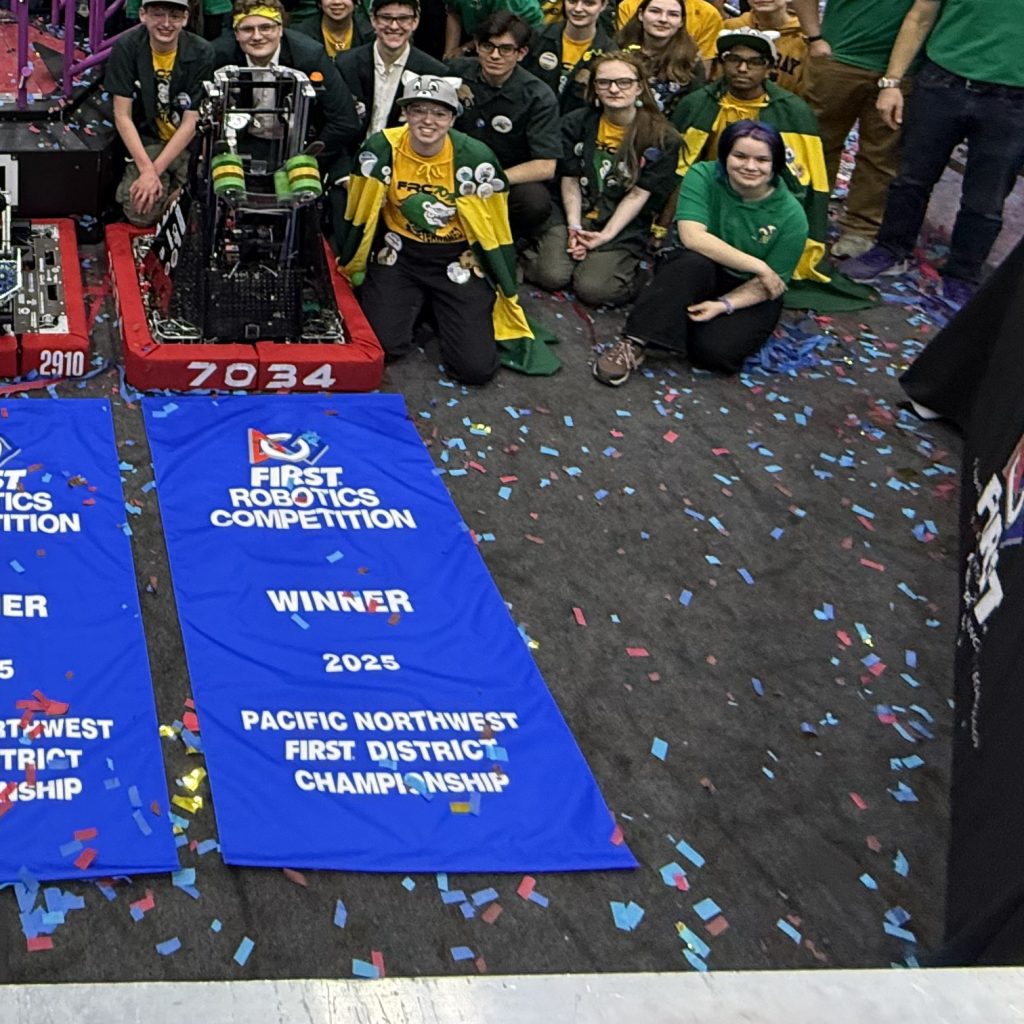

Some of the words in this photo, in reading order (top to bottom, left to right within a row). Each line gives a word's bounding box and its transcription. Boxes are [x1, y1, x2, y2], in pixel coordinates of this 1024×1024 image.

[39, 349, 84, 376] 2910
[187, 361, 336, 390] 7034
[251, 465, 343, 487] FIRST
[229, 487, 380, 507] ROBOTICS
[210, 509, 417, 529] COMPETITION
[266, 589, 414, 612] WINNER
[323, 653, 400, 672] 2025
[241, 710, 348, 730] PACIFIC
[354, 710, 519, 731] NORTHWEST
[285, 740, 355, 761] FIRST
